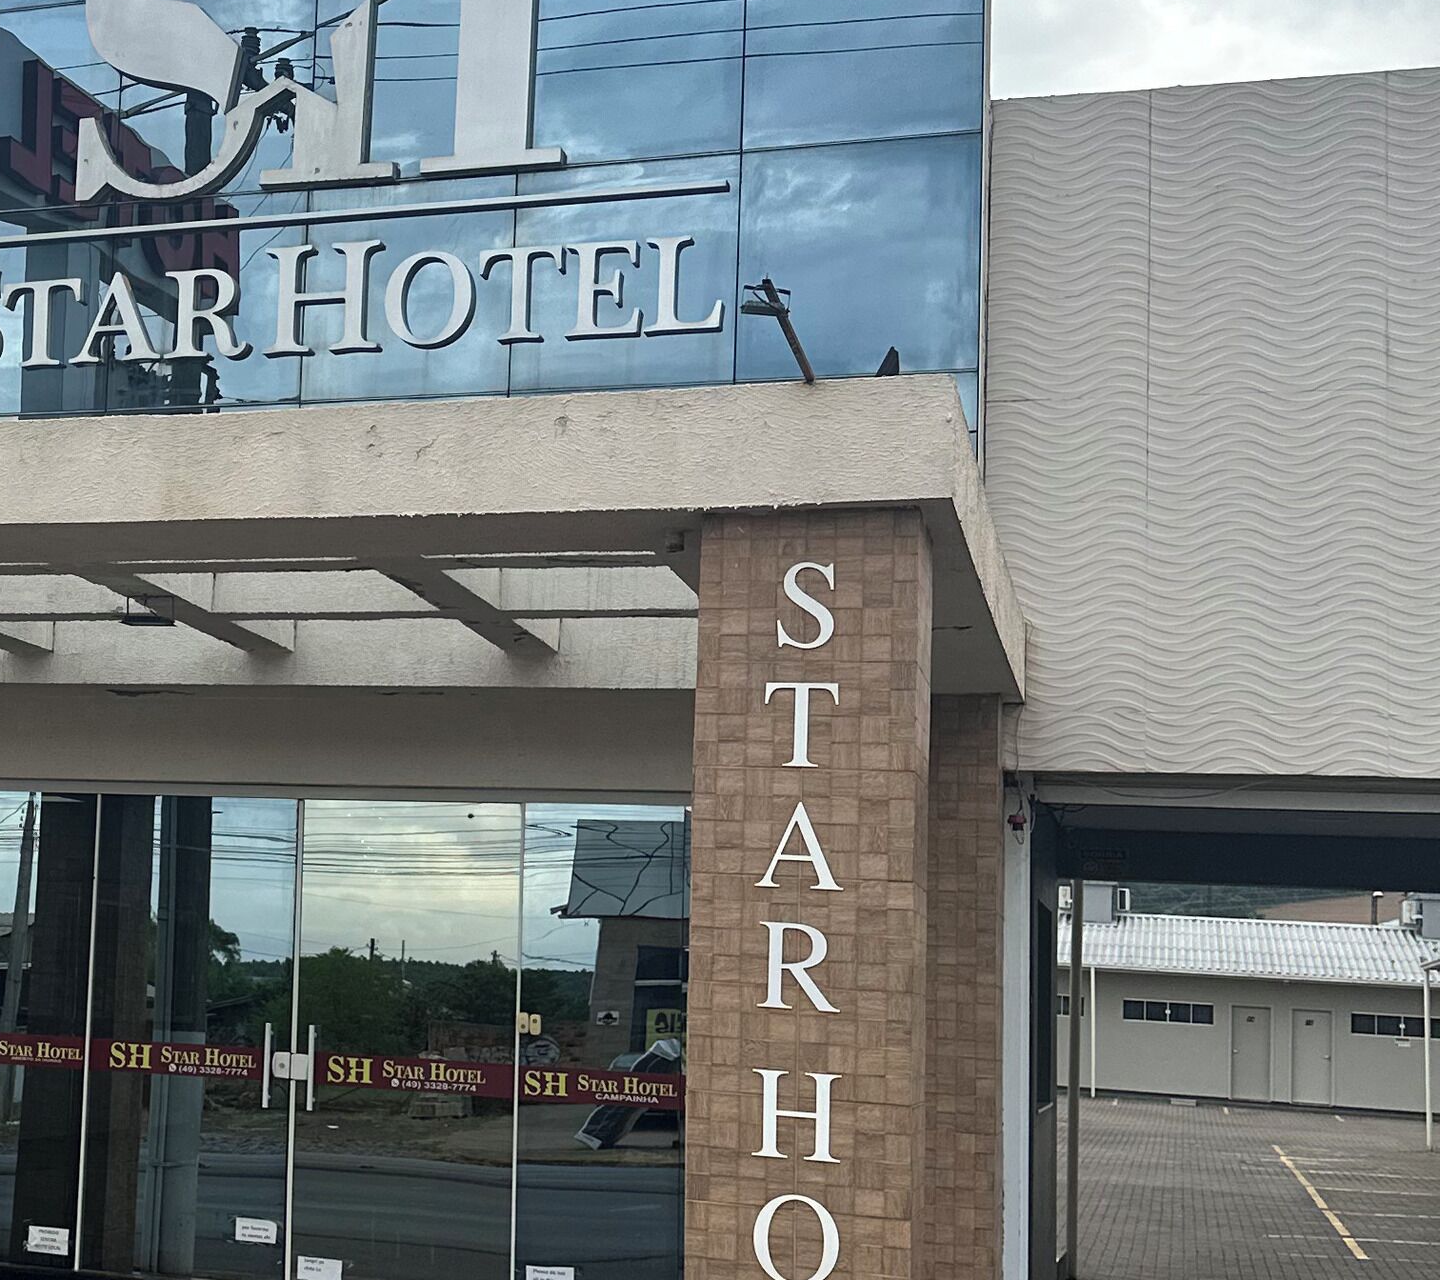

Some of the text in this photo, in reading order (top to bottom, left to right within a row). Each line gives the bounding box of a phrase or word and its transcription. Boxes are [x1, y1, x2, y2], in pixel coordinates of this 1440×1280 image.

[263, 235, 726, 358] HOTEL
[754, 561, 844, 1014] STAR
[37, 1042, 83, 1060] HOTEL
[110, 1041, 256, 1069] SH STAR HOTEL
[178, 1066, 196, 1074] (49)
[327, 1055, 486, 1084] SH STAR HOTEL
[402, 1080, 421, 1089] (49)
[524, 1070, 678, 1097] SH STAR HOTEL
[595, 1092, 659, 1103] CAMPAINHA
